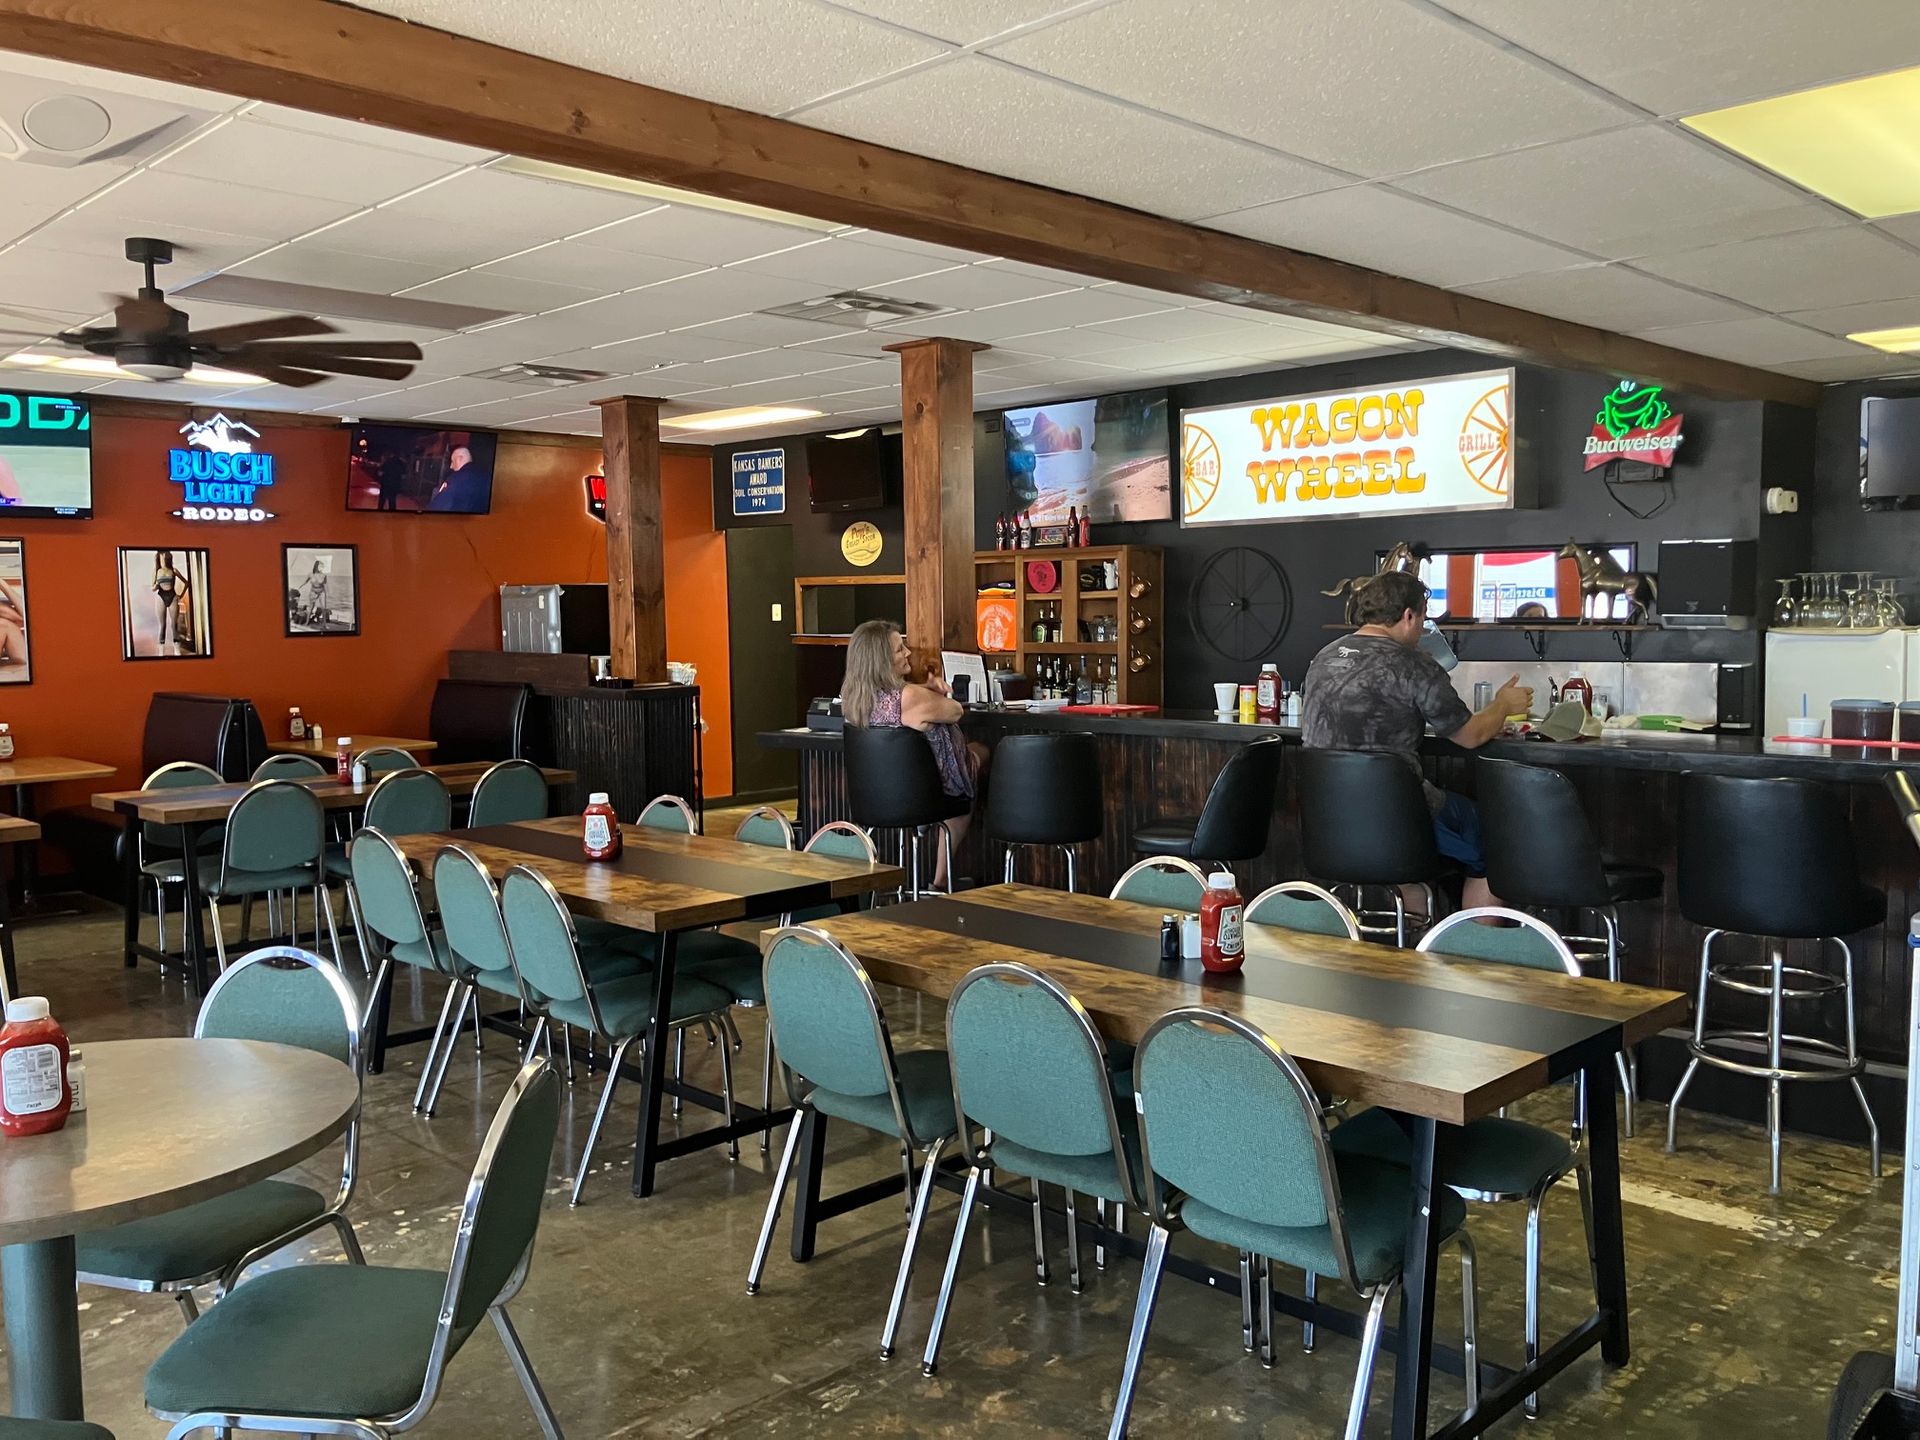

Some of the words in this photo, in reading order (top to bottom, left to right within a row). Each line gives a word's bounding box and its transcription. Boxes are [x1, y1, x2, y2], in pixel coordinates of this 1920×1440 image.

[1250, 389, 1424, 451] WAGON
[1458, 432, 1495, 453] GRILL
[1582, 433, 1683, 454] Budweiser
[168, 448, 274, 485] BUSCH
[734, 459, 756, 472] KANSAS
[757, 455, 783, 471] BANKERS
[1195, 460, 1215, 477] BAR
[749, 472, 768, 486] AWARD
[1246, 446, 1426, 504] WHEEL
[184, 481, 256, 504] LIGHT
[734, 488, 746, 498] SOIL
[747, 485, 784, 497] CONSERVATION
[752, 497, 766, 507] 1974
[182, 506, 266, 521] RODEO
